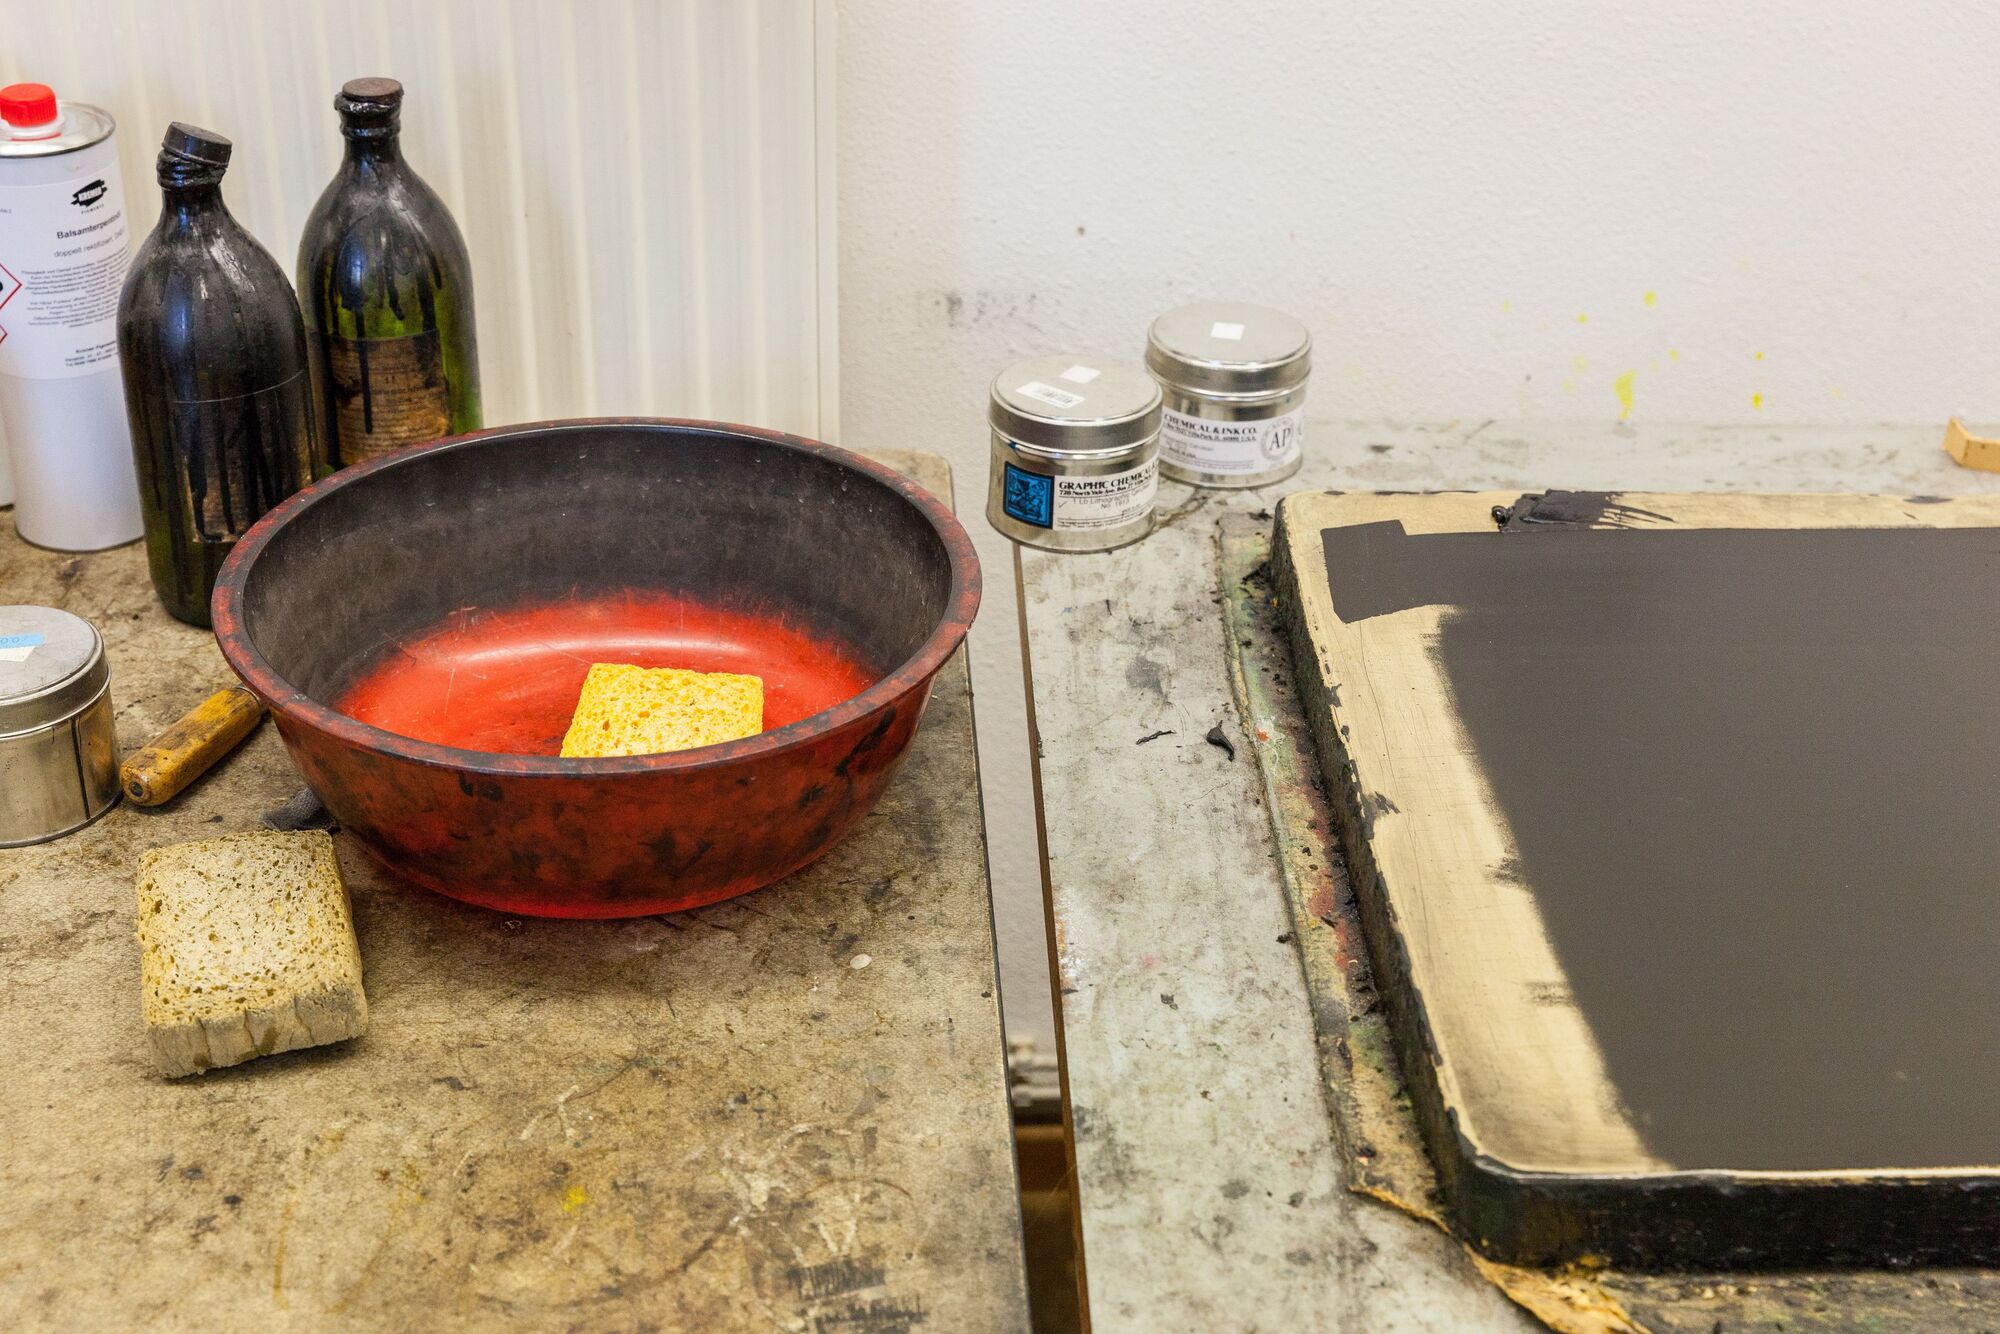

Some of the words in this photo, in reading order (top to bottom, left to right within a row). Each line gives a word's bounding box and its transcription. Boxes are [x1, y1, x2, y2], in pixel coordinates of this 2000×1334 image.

[1222, 427, 1240, 435] INK
[1268, 427, 1292, 451] AP
[1058, 480, 1109, 491] GRAPHIC
[1072, 489, 1091, 497] North
